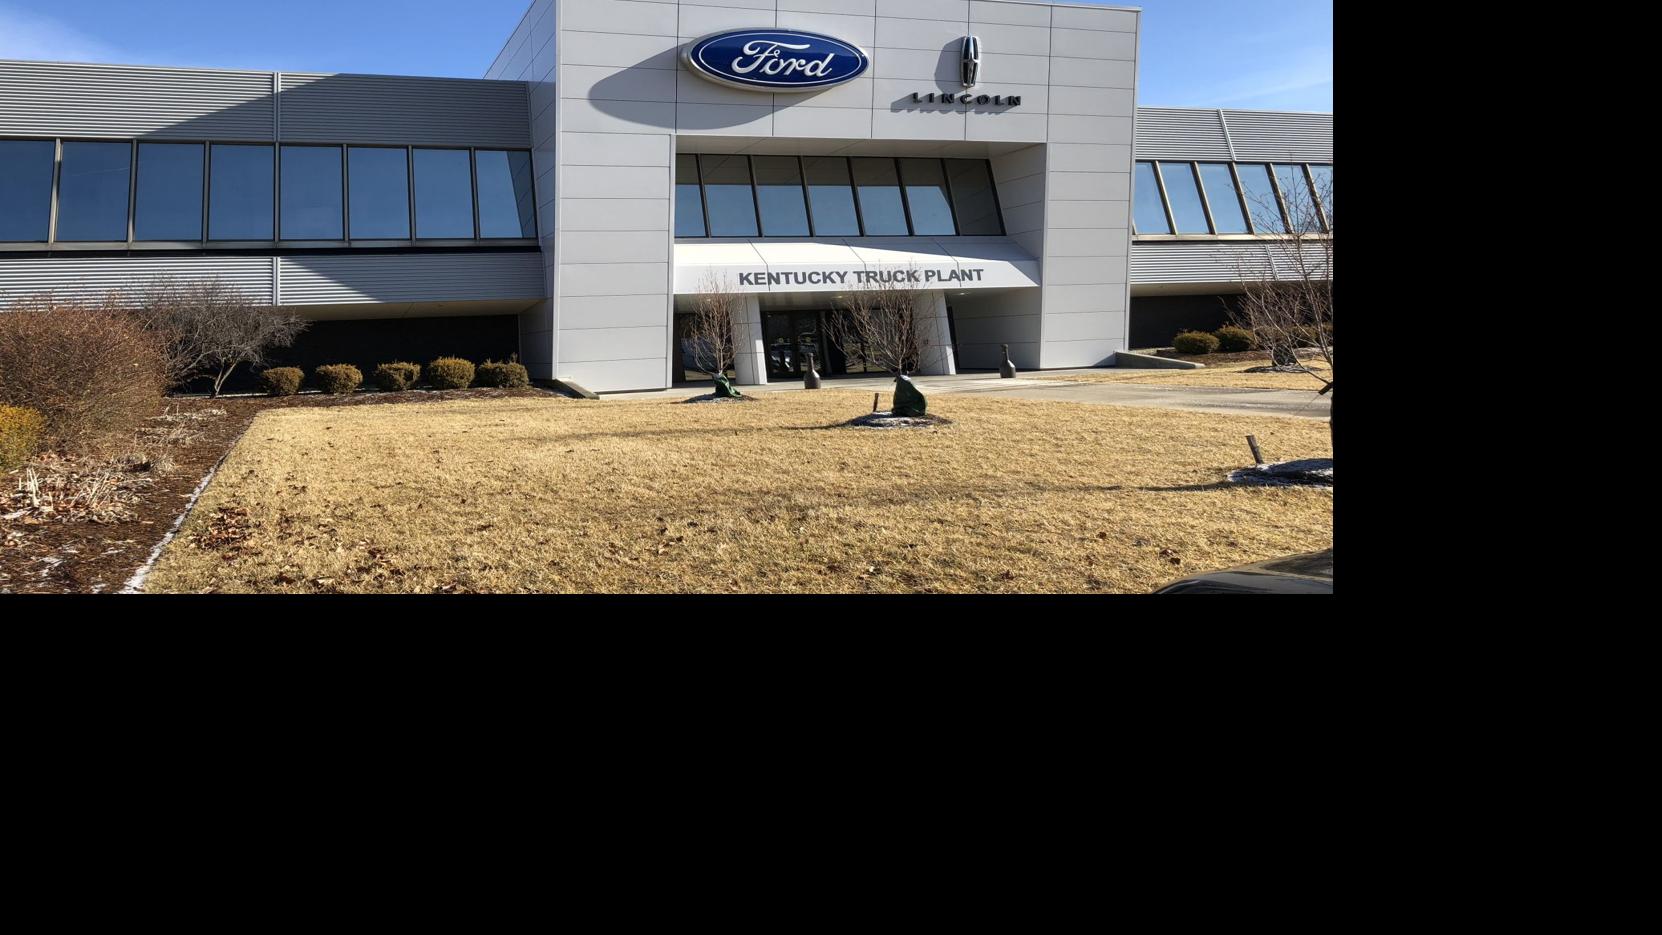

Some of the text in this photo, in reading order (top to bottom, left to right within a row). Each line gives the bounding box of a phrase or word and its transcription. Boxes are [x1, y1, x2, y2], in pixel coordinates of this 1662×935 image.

[731, 39, 835, 78] Ford
[912, 91, 1022, 107] LINCOLN
[738, 268, 985, 286] KENTUCKY TRUCK PLANT
